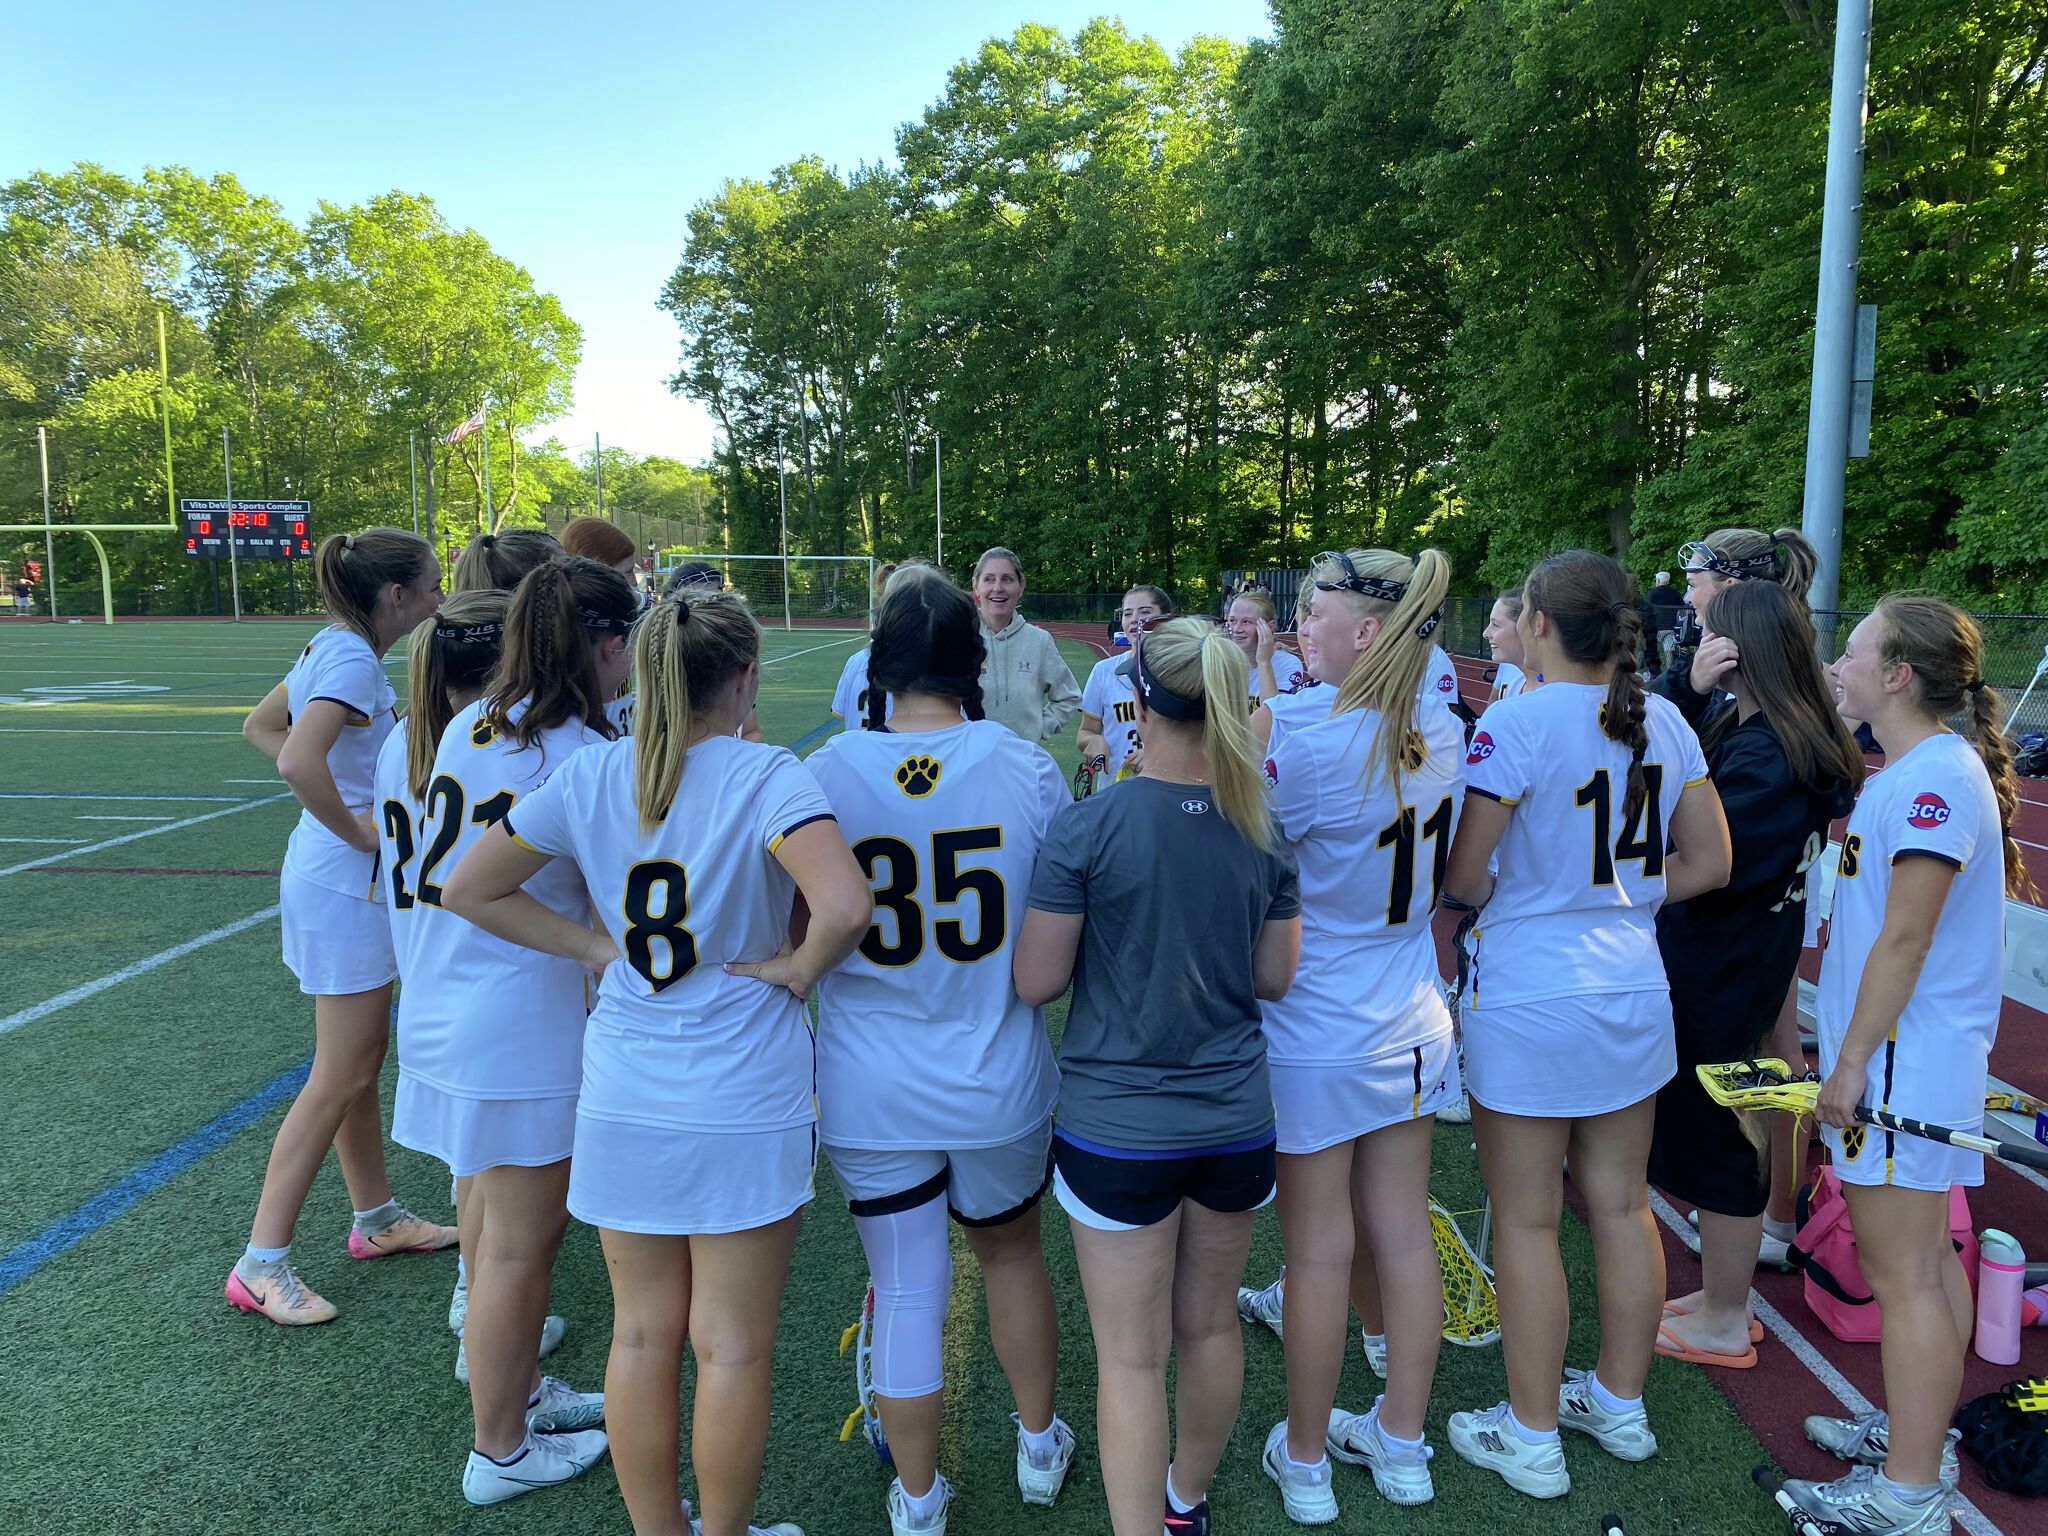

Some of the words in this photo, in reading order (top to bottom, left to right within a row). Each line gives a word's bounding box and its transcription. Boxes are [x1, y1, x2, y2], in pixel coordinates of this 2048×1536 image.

[238, 502, 265, 511] Sports
[266, 503, 303, 511] Complex
[284, 514, 305, 522] GUEST
[200, 521, 210, 535] 0
[295, 522, 304, 535] 0
[1361, 586, 1397, 600] STX
[1574, 763, 1664, 886] 14
[1376, 794, 1453, 926] 11
[850, 824, 1007, 968] 35
[622, 859, 700, 993] 8
